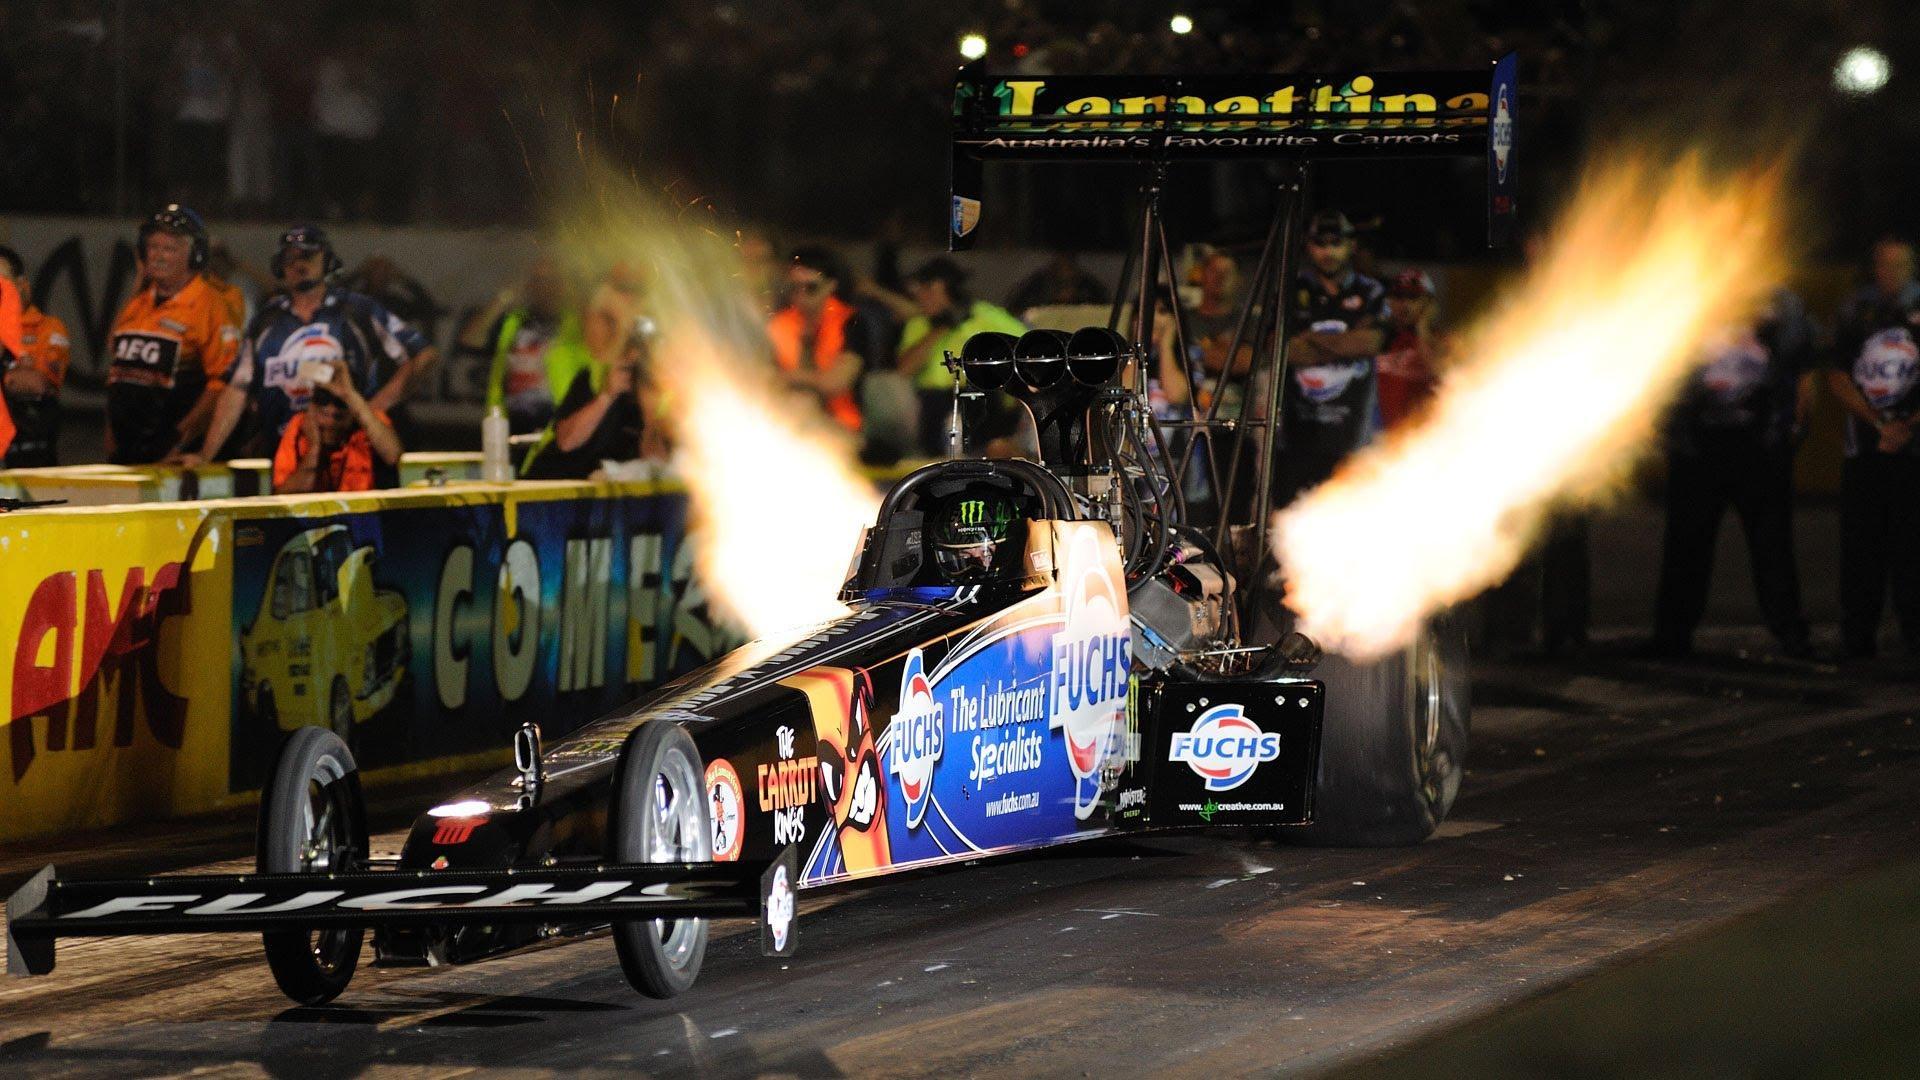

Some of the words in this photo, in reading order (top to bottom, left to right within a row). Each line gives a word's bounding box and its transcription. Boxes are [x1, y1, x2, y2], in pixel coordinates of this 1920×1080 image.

[982, 136, 1150, 150] Australia's
[1164, 133, 1318, 148] Favourite
[1333, 131, 1461, 146] Carrots
[11, 561, 191, 785] AMC
[1053, 627, 1132, 716] FUCHS
[951, 684, 978, 733] The
[980, 678, 1046, 730] Lubricant
[892, 709, 943, 768] FUCHS
[969, 726, 1043, 792] Specialists
[1174, 737, 1277, 759] FUCHS
[758, 756, 818, 813] CARROT
[985, 791, 1040, 818] www.fuchs.com.au
[60, 880, 741, 920] FUCHS
